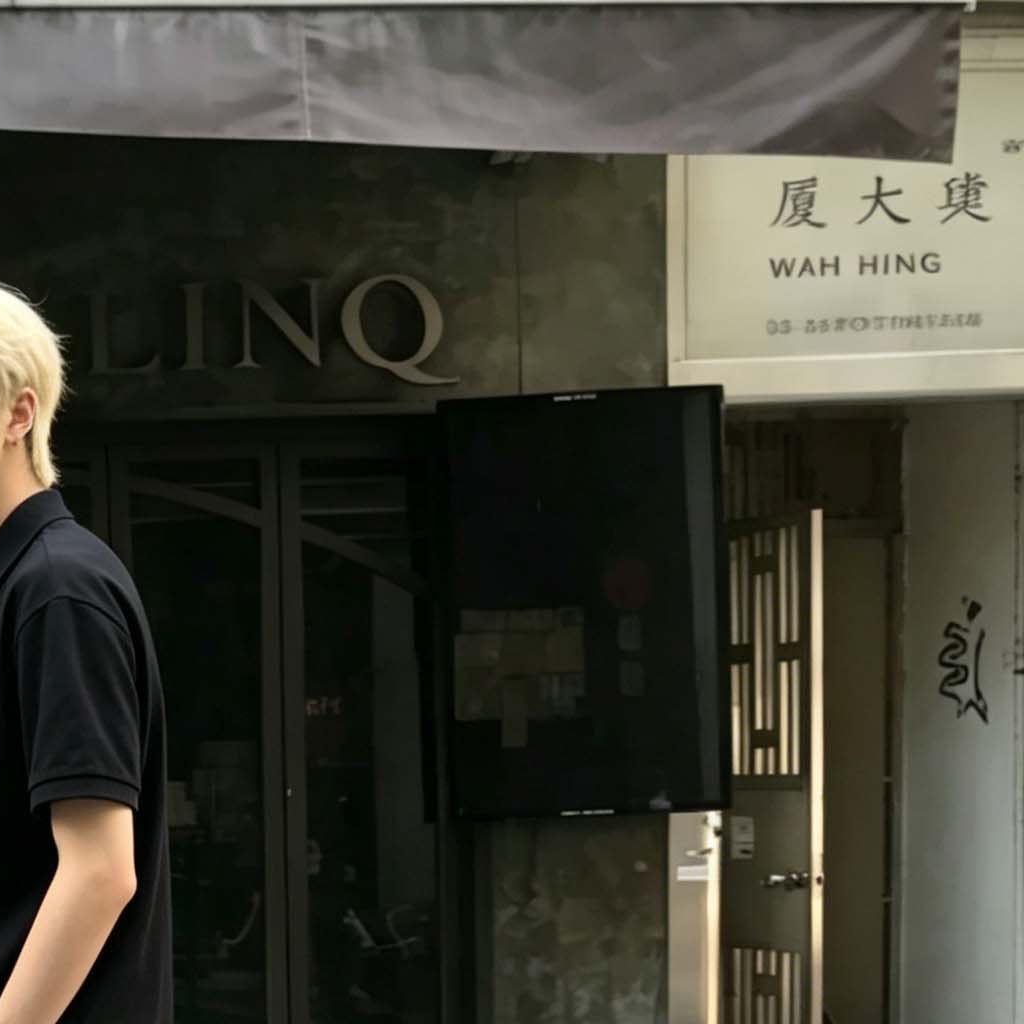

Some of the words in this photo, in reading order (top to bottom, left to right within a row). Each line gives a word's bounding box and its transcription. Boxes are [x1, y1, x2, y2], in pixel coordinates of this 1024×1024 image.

[769, 255, 840, 279] WAH
[858, 252, 942, 276] HING
[86, 273, 460, 386] LINQ
